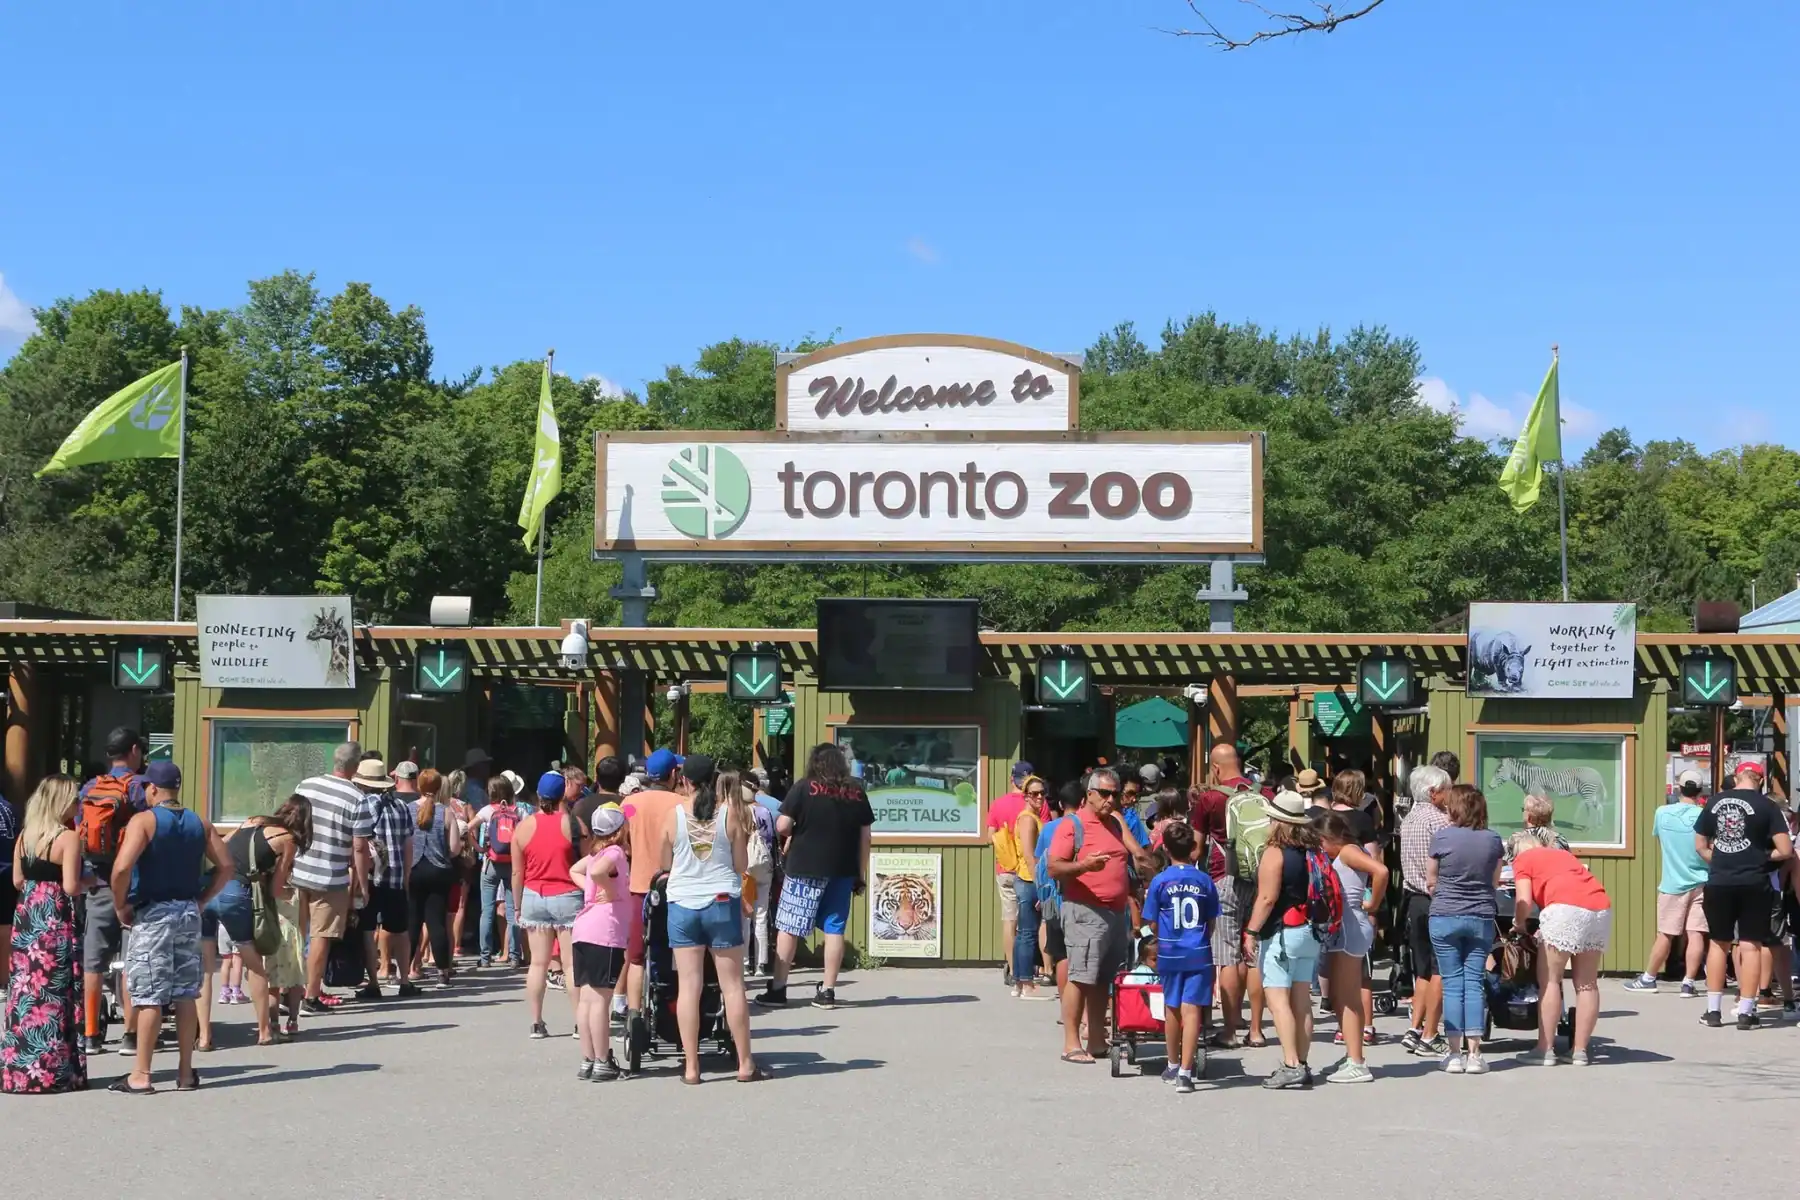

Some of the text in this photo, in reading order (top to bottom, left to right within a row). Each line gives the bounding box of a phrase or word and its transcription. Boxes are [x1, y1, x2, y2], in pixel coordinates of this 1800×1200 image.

[808, 369, 1054, 420] Welcome to
[777, 461, 1193, 521] toronto zoo
[205, 623, 297, 642] CONNECTING
[1549, 624, 1616, 640] WORKING
[212, 639, 246, 652] people
[1550, 642, 1616, 655] together to
[211, 657, 269, 667] WILDLIFE
[1534, 657, 1630, 671] FIGHT extinction
[872, 808, 961, 822] EPER TALKS
[1166, 884, 1200, 895] HAZARD
[1171, 896, 1199, 929] 10
